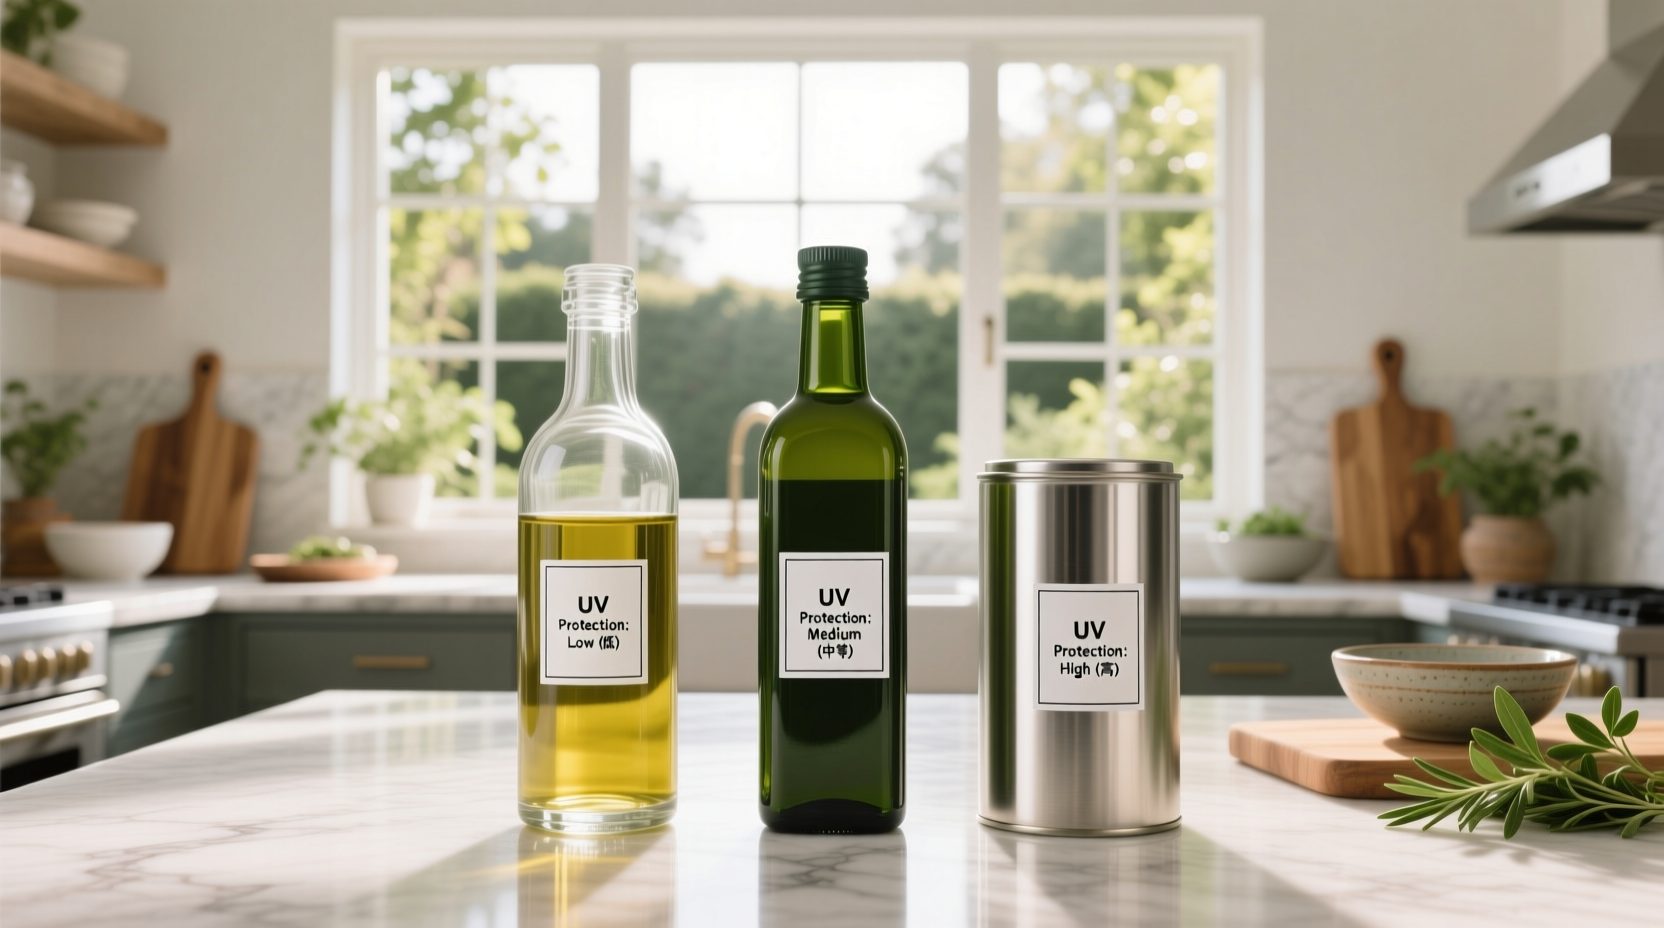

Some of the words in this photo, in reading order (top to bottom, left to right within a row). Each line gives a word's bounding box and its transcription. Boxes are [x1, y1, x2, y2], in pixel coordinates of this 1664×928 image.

[578, 595, 610, 614] UV
[818, 587, 851, 607] UV
[558, 618, 629, 632] Protection:
[799, 610, 872, 625] Protection:
[807, 626, 862, 641] Medium
[1073, 620, 1106, 640] UV
[567, 636, 595, 649] Low
[1053, 644, 1128, 658] Protection:
